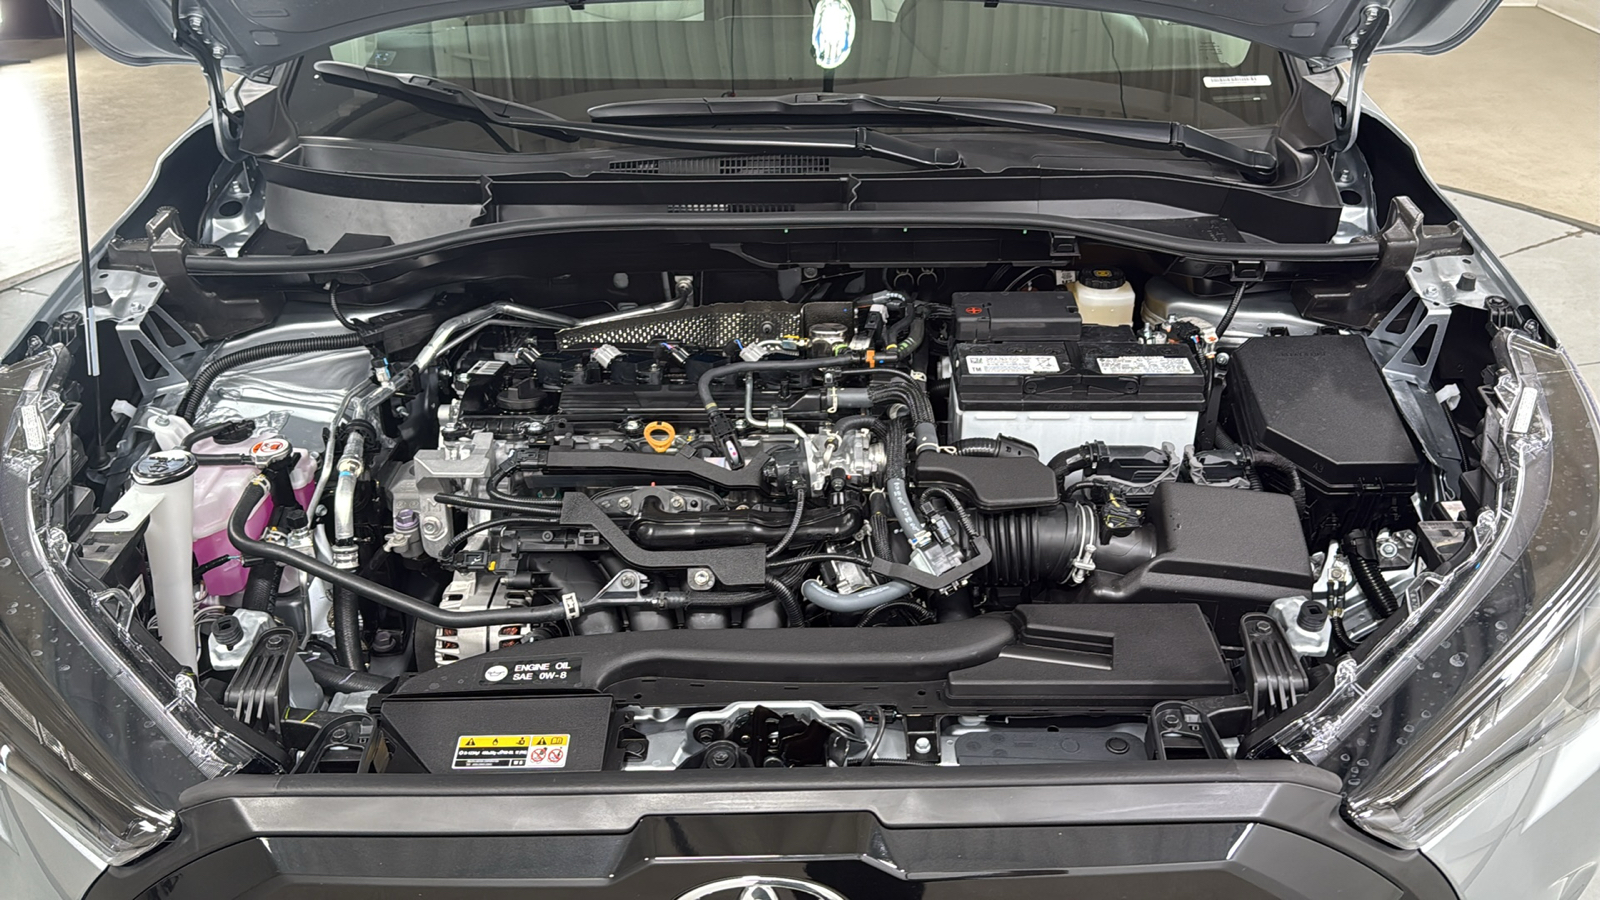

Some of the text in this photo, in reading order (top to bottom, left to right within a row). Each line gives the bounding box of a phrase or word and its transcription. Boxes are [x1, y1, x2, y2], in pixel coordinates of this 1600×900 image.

[514, 661, 571, 672] ENGINE OIL
[513, 671, 567, 681] SAE 0W-8
